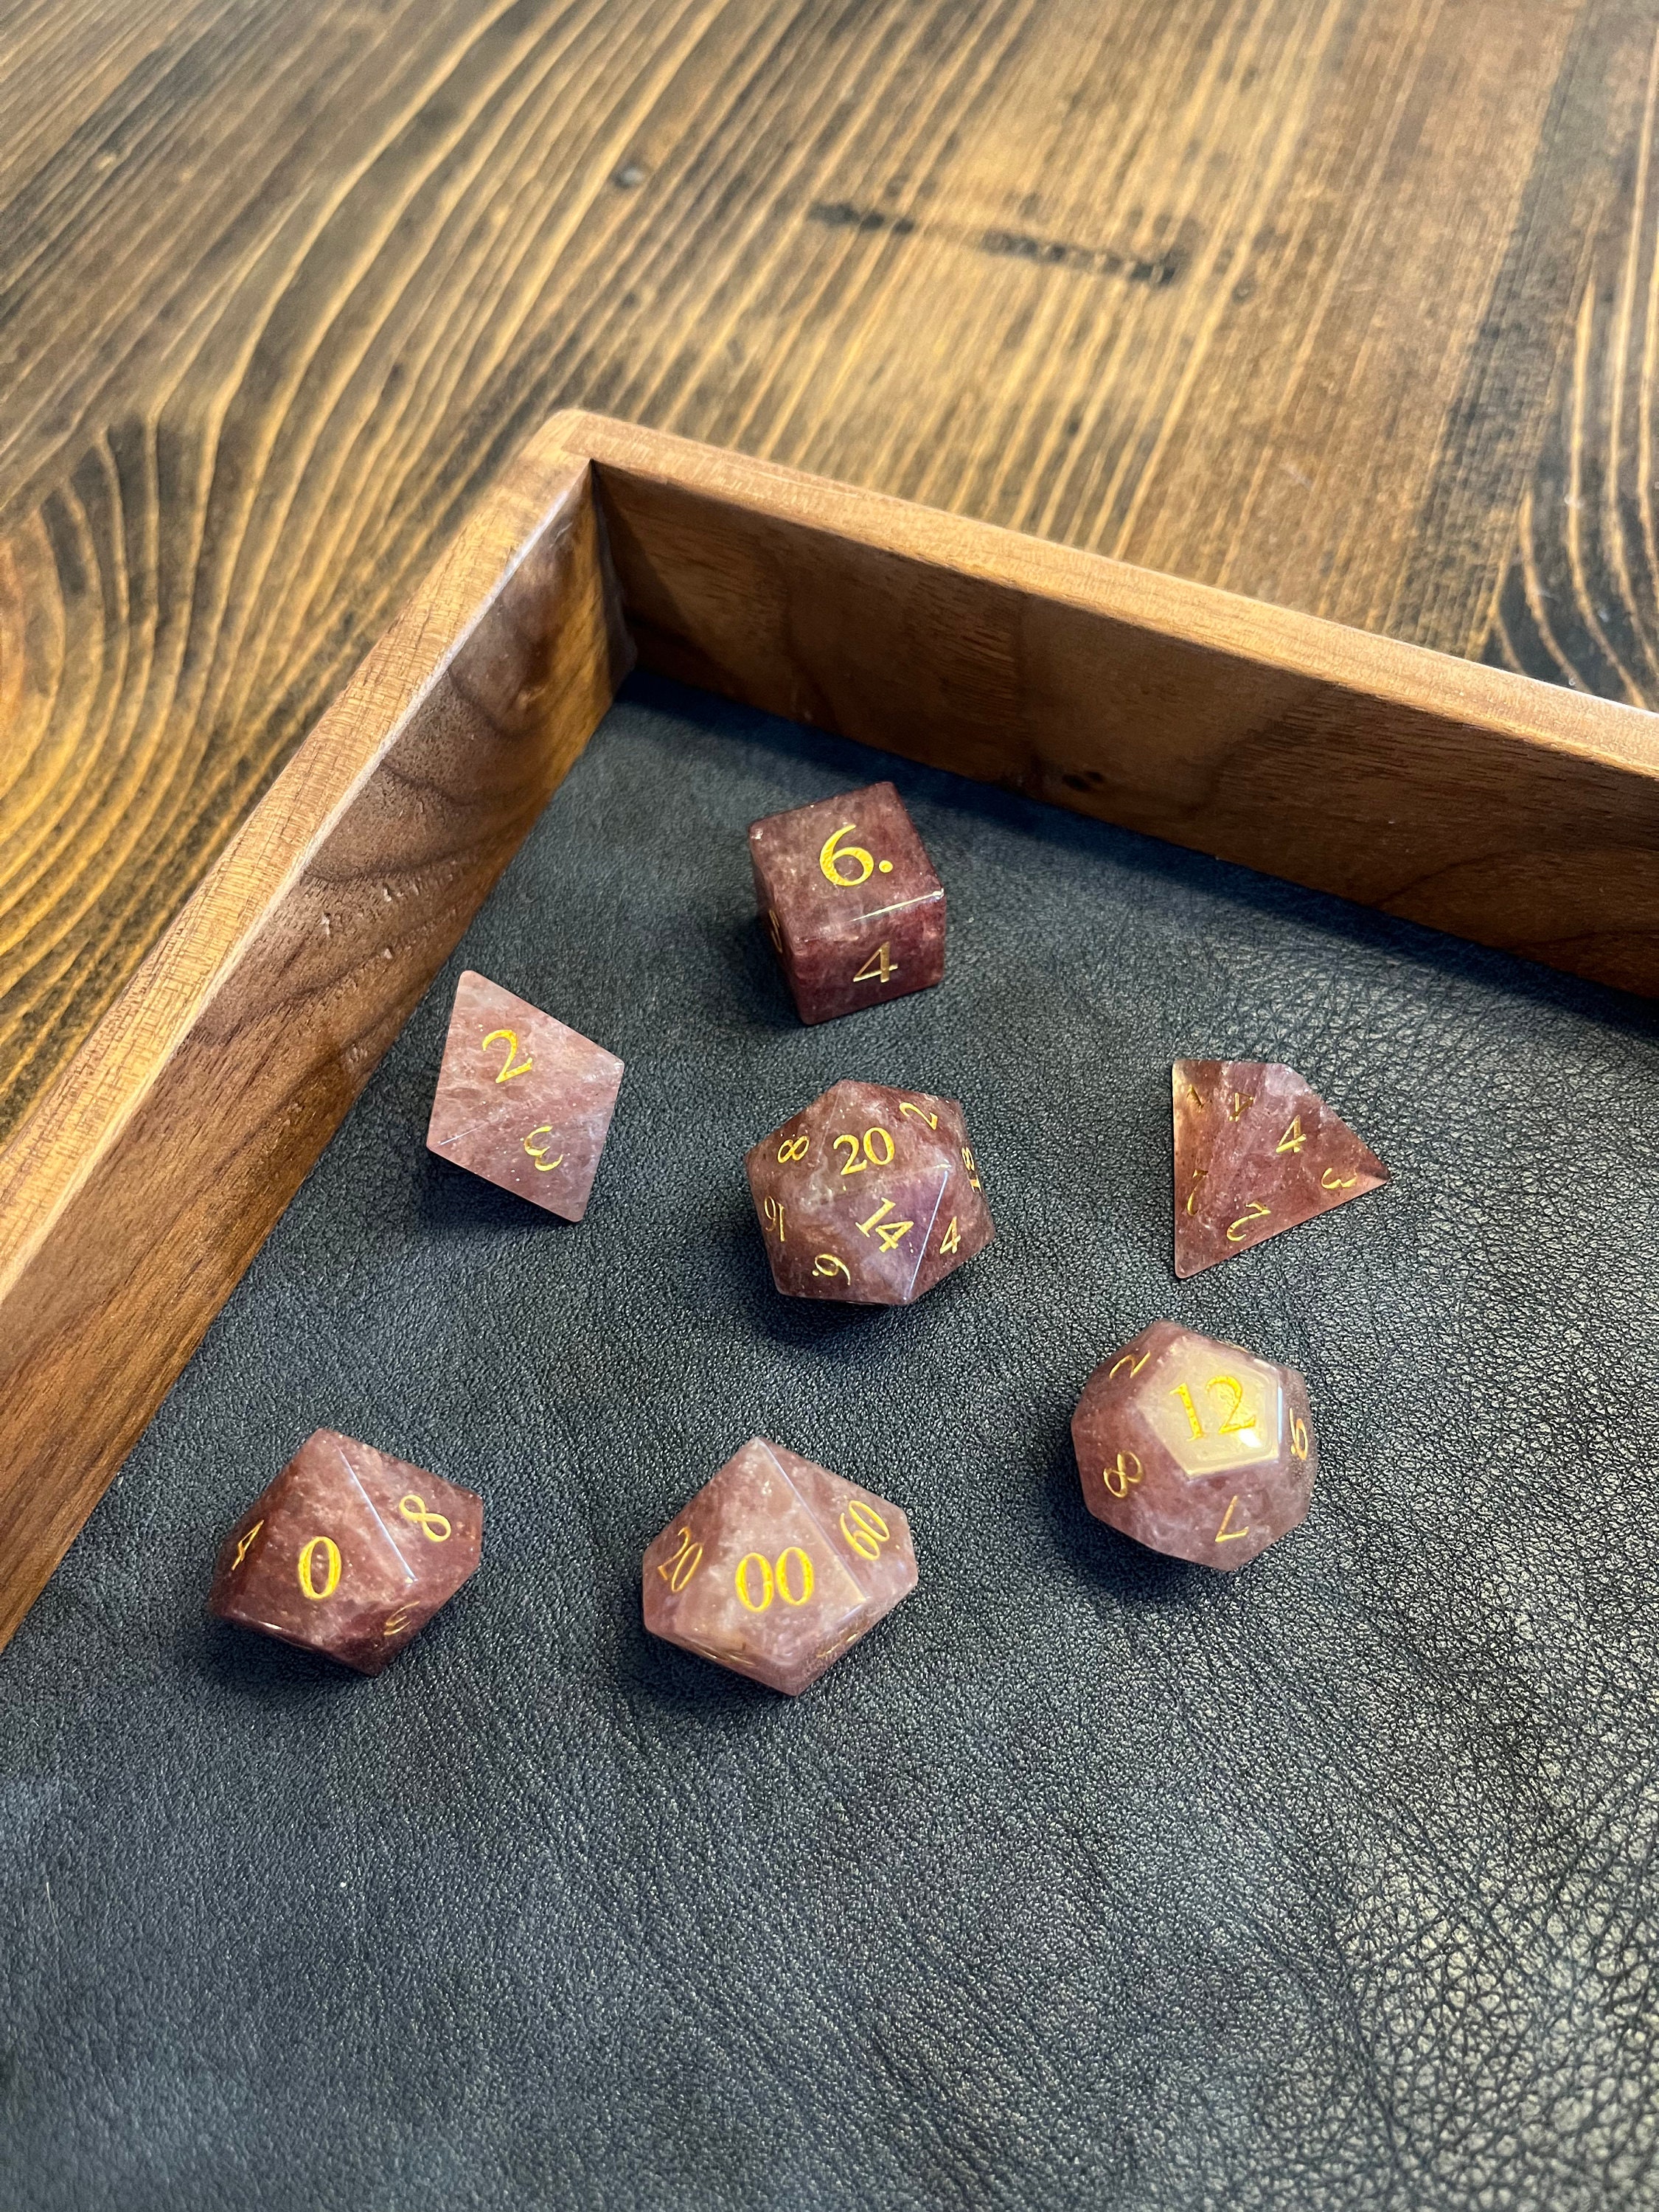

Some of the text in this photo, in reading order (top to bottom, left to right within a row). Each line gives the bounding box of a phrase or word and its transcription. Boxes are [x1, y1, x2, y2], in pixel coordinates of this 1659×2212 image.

[852, 941, 898, 983] 4
[482, 1029, 533, 1084] 2
[900, 1102, 938, 1130] 2
[1276, 1115, 1307, 1152] 4
[524, 1125, 563, 1172] 3
[777, 1135, 810, 1164] 8
[833, 1127, 894, 1175] 20
[1321, 1167, 1357, 1189] 3
[855, 1197, 914, 1253] 14
[939, 1217, 961, 1254] 4
[1226, 1203, 1271, 1242] 2
[1109, 1351, 1150, 1380] 2
[1169, 1375, 1256, 1441] 12
[1103, 1450, 1141, 1498] 8
[399, 1494, 452, 1543] 8
[840, 1500, 890, 1561] 60
[1215, 1495, 1249, 1543] 7
[231, 1520, 264, 1571] 4
[298, 1536, 342, 1600] 0
[658, 1526, 703, 1593] 20
[735, 1546, 815, 1613] 00
